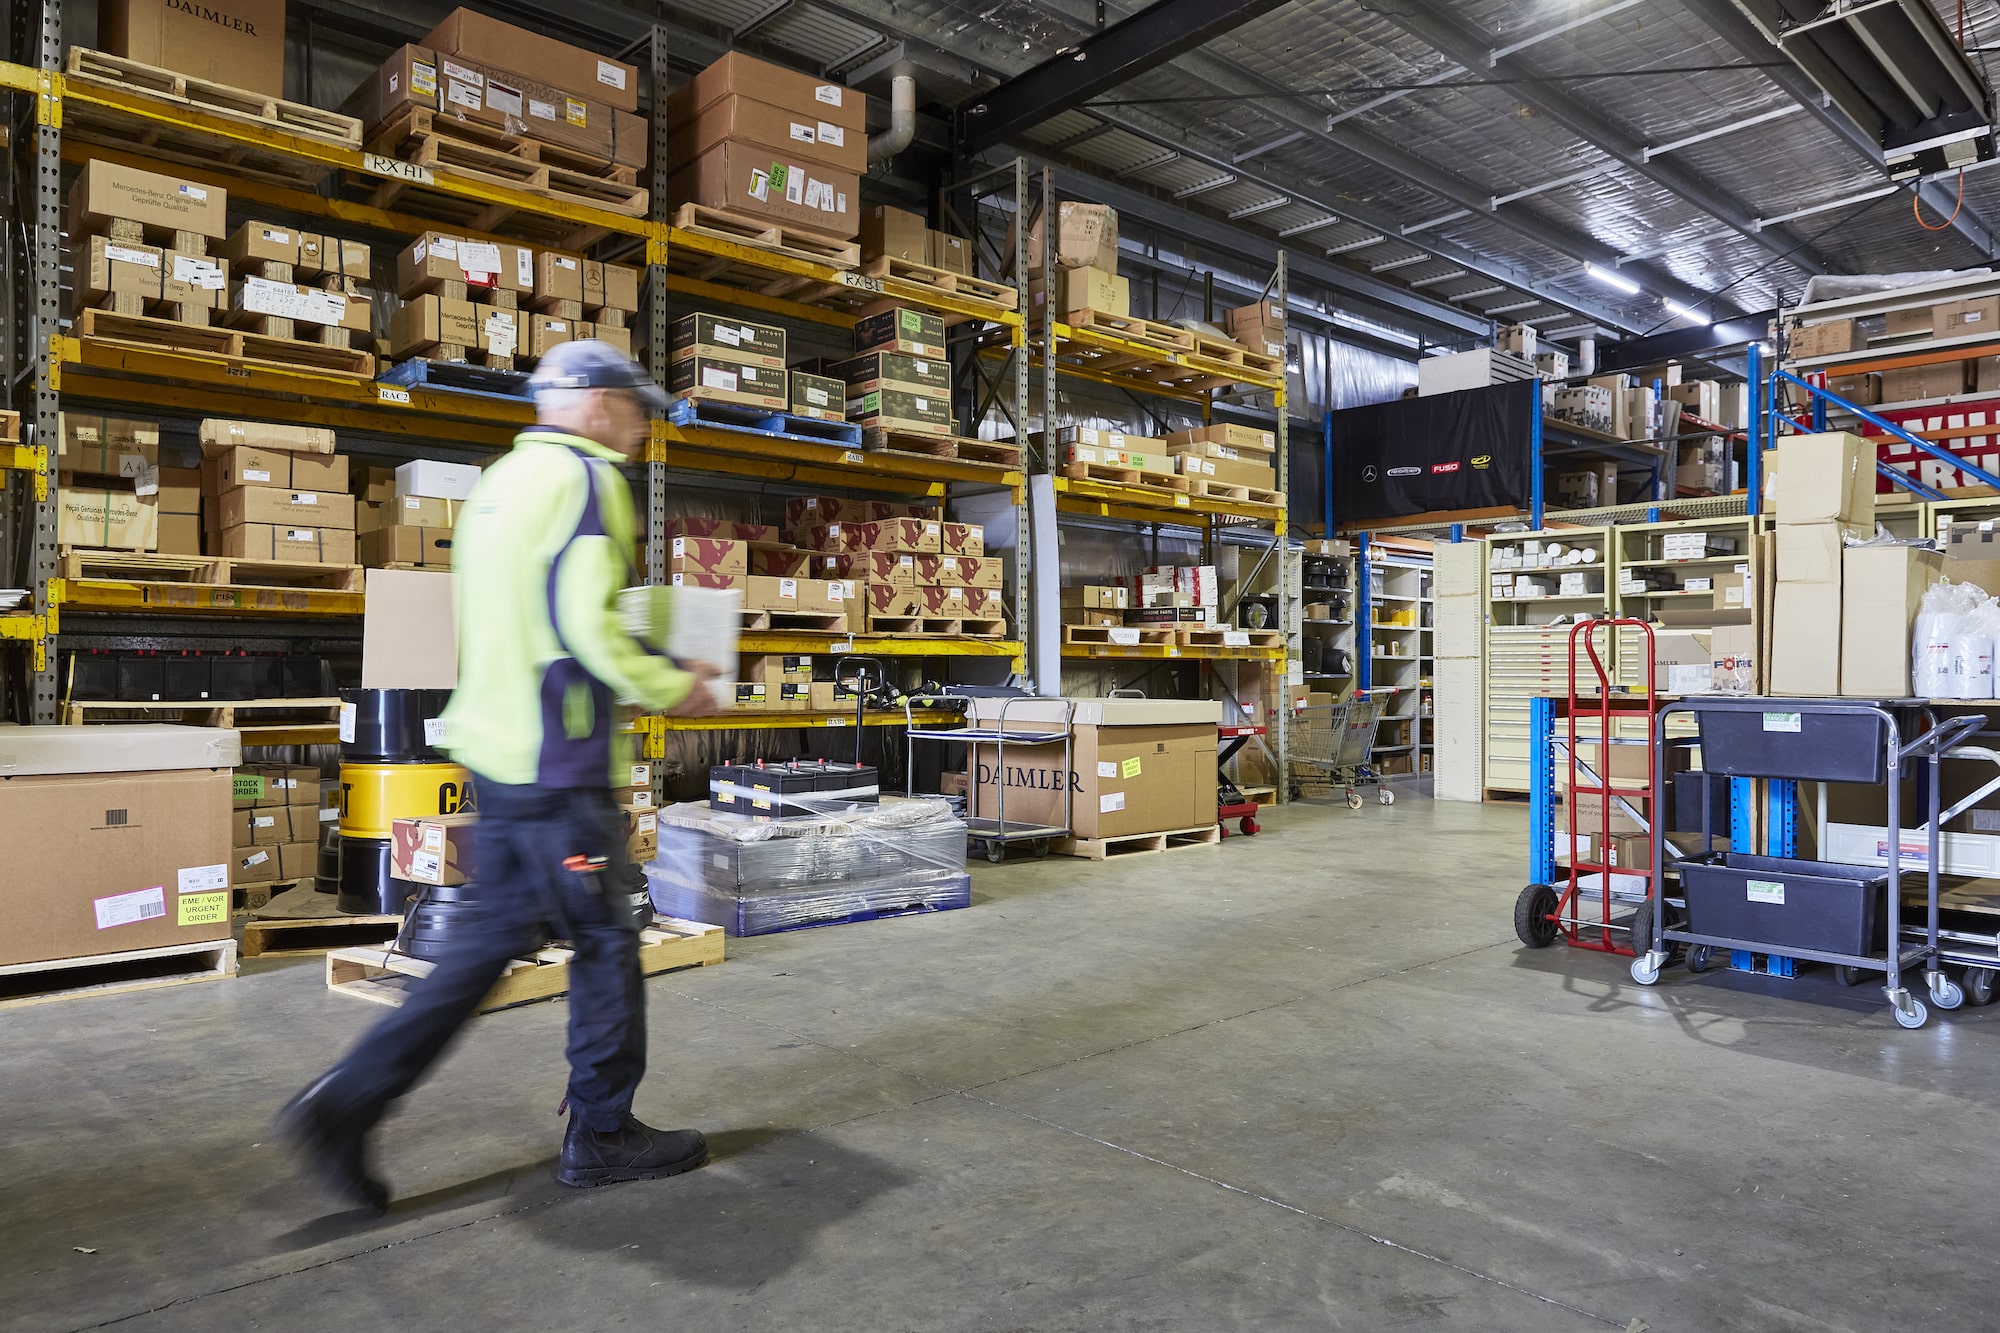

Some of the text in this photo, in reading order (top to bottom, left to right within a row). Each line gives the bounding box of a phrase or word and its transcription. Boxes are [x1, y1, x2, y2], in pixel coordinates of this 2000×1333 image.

[165, 0, 257, 37] DAIMLER
[374, 157, 399, 173] RX
[112, 182, 164, 199] Mercedes-Benz
[132, 195, 189, 213] Geprüfte Qualität
[441, 312, 480, 324] Mercedes-Bez
[381, 390, 409, 401] RAC2
[1433, 464, 1458, 472] FUSO
[977, 764, 1084, 793] DAIMLER
[439, 782, 478, 816] CA
[207, 895, 224, 903] VOR
[185, 905, 220, 913] URGENT
[188, 913, 218, 922] ORDER
